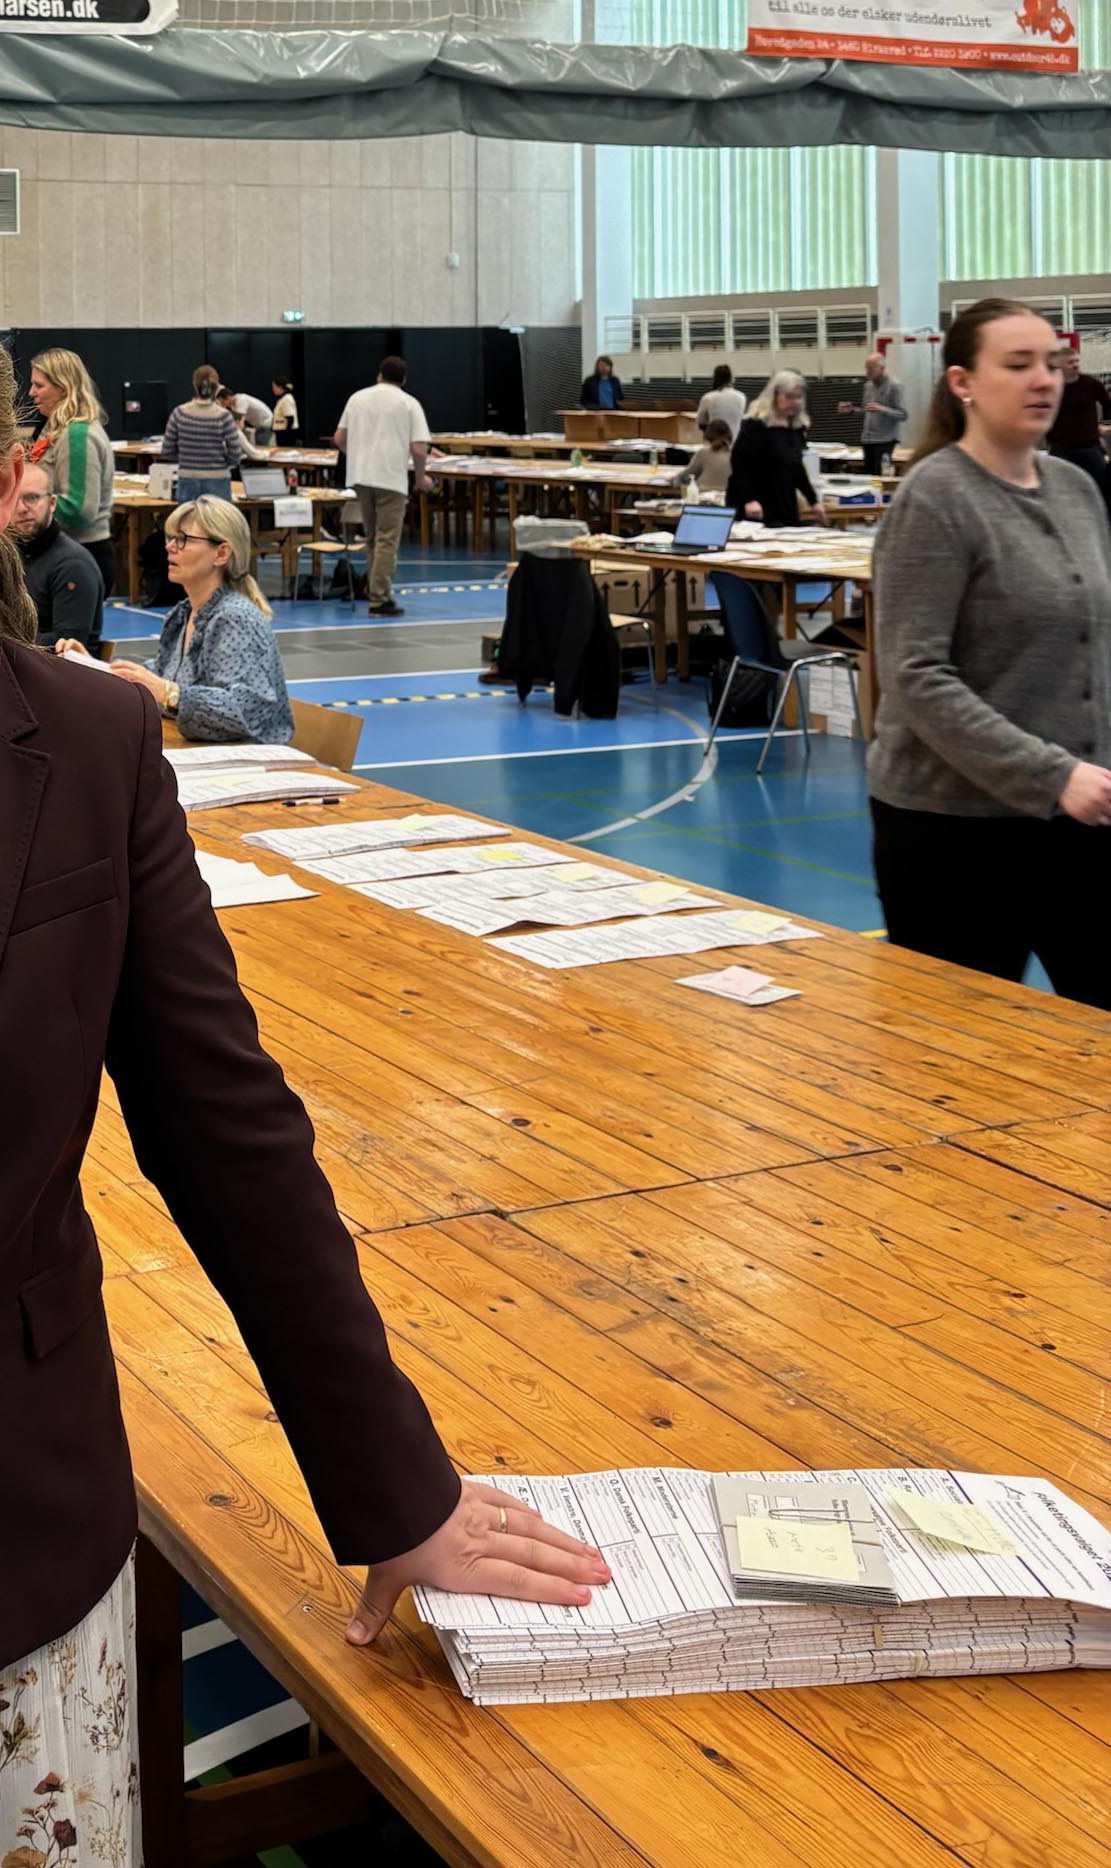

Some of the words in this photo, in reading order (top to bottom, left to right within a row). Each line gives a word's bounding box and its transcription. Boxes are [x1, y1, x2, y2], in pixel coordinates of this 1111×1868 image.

[793, 1, 818, 16] alle
[838, 5, 859, 18] der
[861, 8, 902, 22] elsker
[613, 1488, 626, 1505] Dansk
[622, 1505, 640, 1534] Folkeparti
